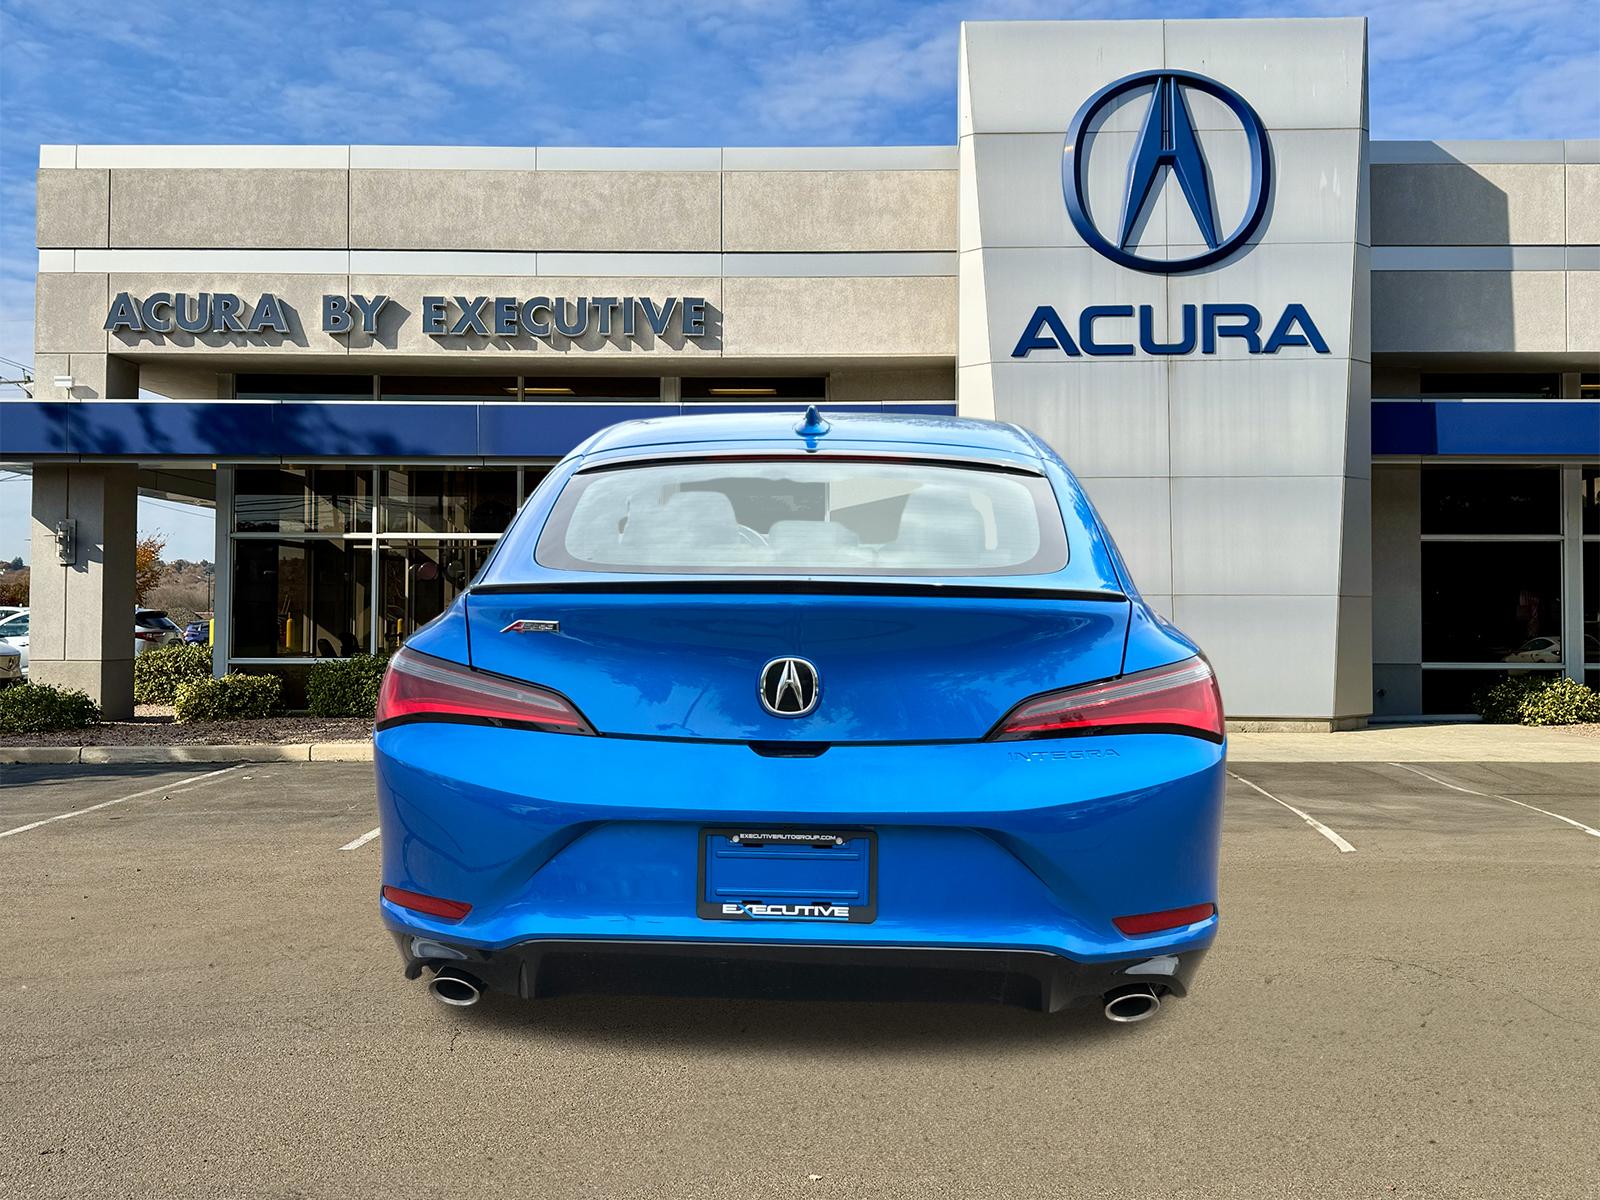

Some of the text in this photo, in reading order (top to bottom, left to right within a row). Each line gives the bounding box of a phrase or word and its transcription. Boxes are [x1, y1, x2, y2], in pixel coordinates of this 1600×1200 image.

[103, 292, 706, 336] ACURA BY EXECUTIVE
[1010, 303, 1332, 357] ACURA
[1007, 748, 1121, 761] INTEGRA
[739, 833, 836, 842] EXECUTIVEAUTOGROUP.COM
[722, 903, 850, 919] EXECUTIVE
